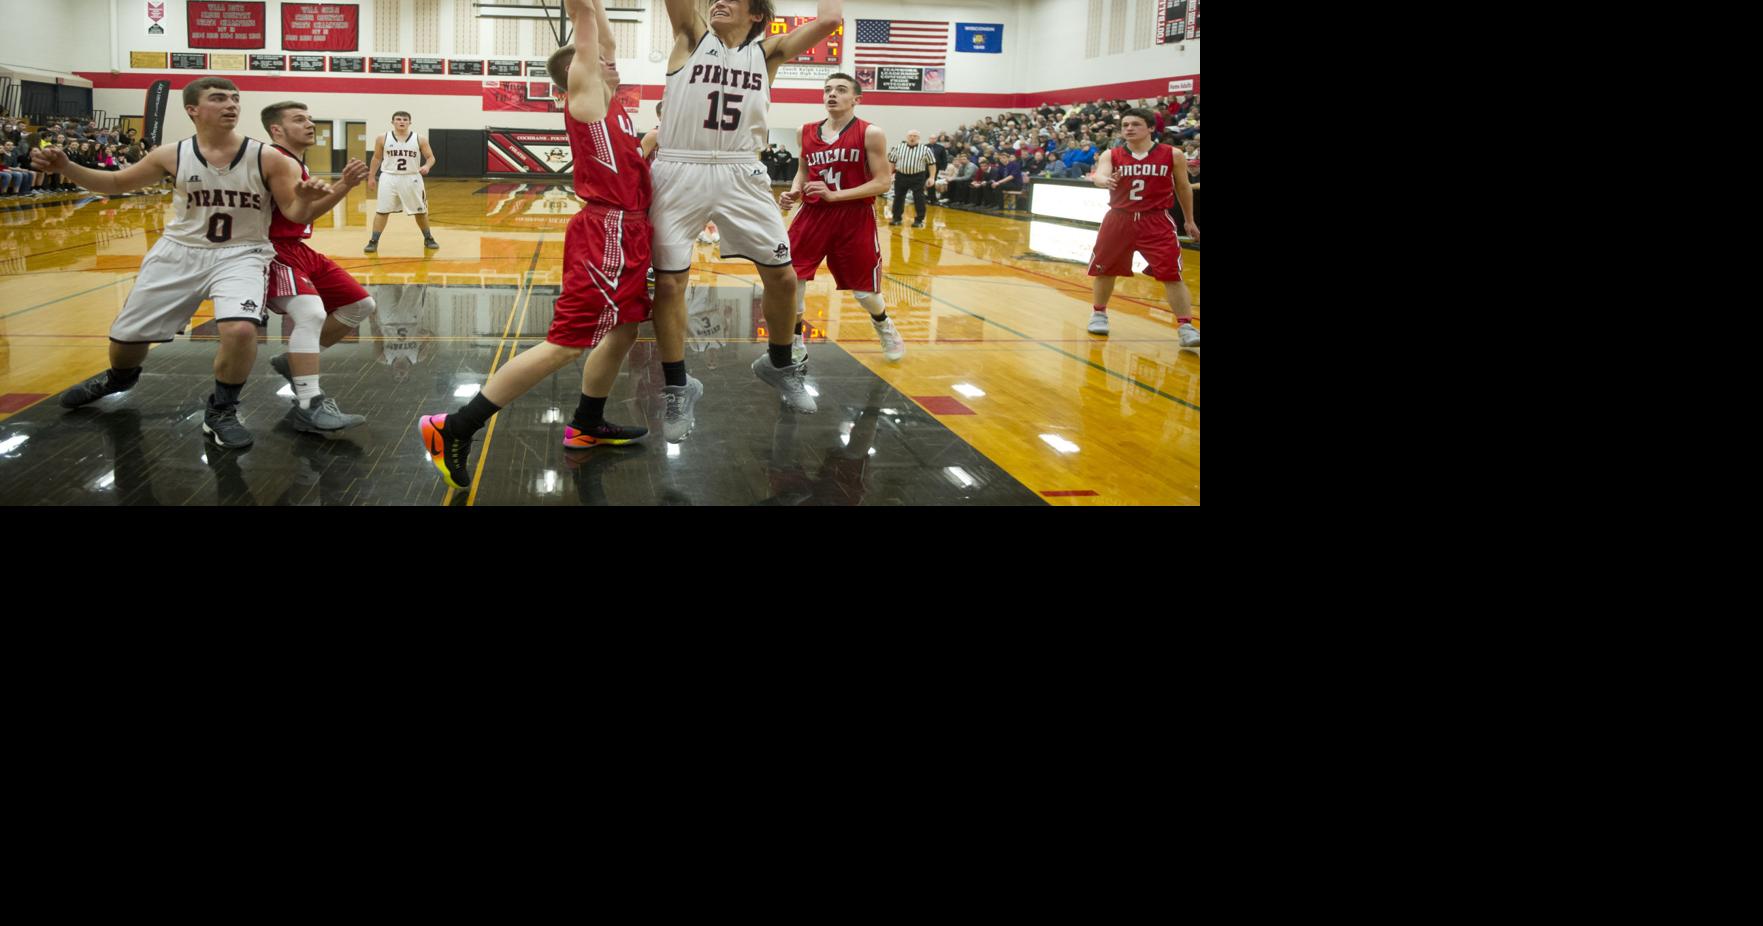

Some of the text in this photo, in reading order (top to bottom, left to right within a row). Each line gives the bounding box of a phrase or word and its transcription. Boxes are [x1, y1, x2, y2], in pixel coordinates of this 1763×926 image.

[689, 64, 762, 91] PIRATES
[703, 90, 744, 131] 15
[386, 150, 417, 158] PIRATES
[397, 158, 407, 170] 2
[1119, 164, 1169, 176] INCOLN
[187, 189, 261, 210] PIRATES
[1129, 179, 1145, 200] 2
[206, 212, 233, 243] 0
